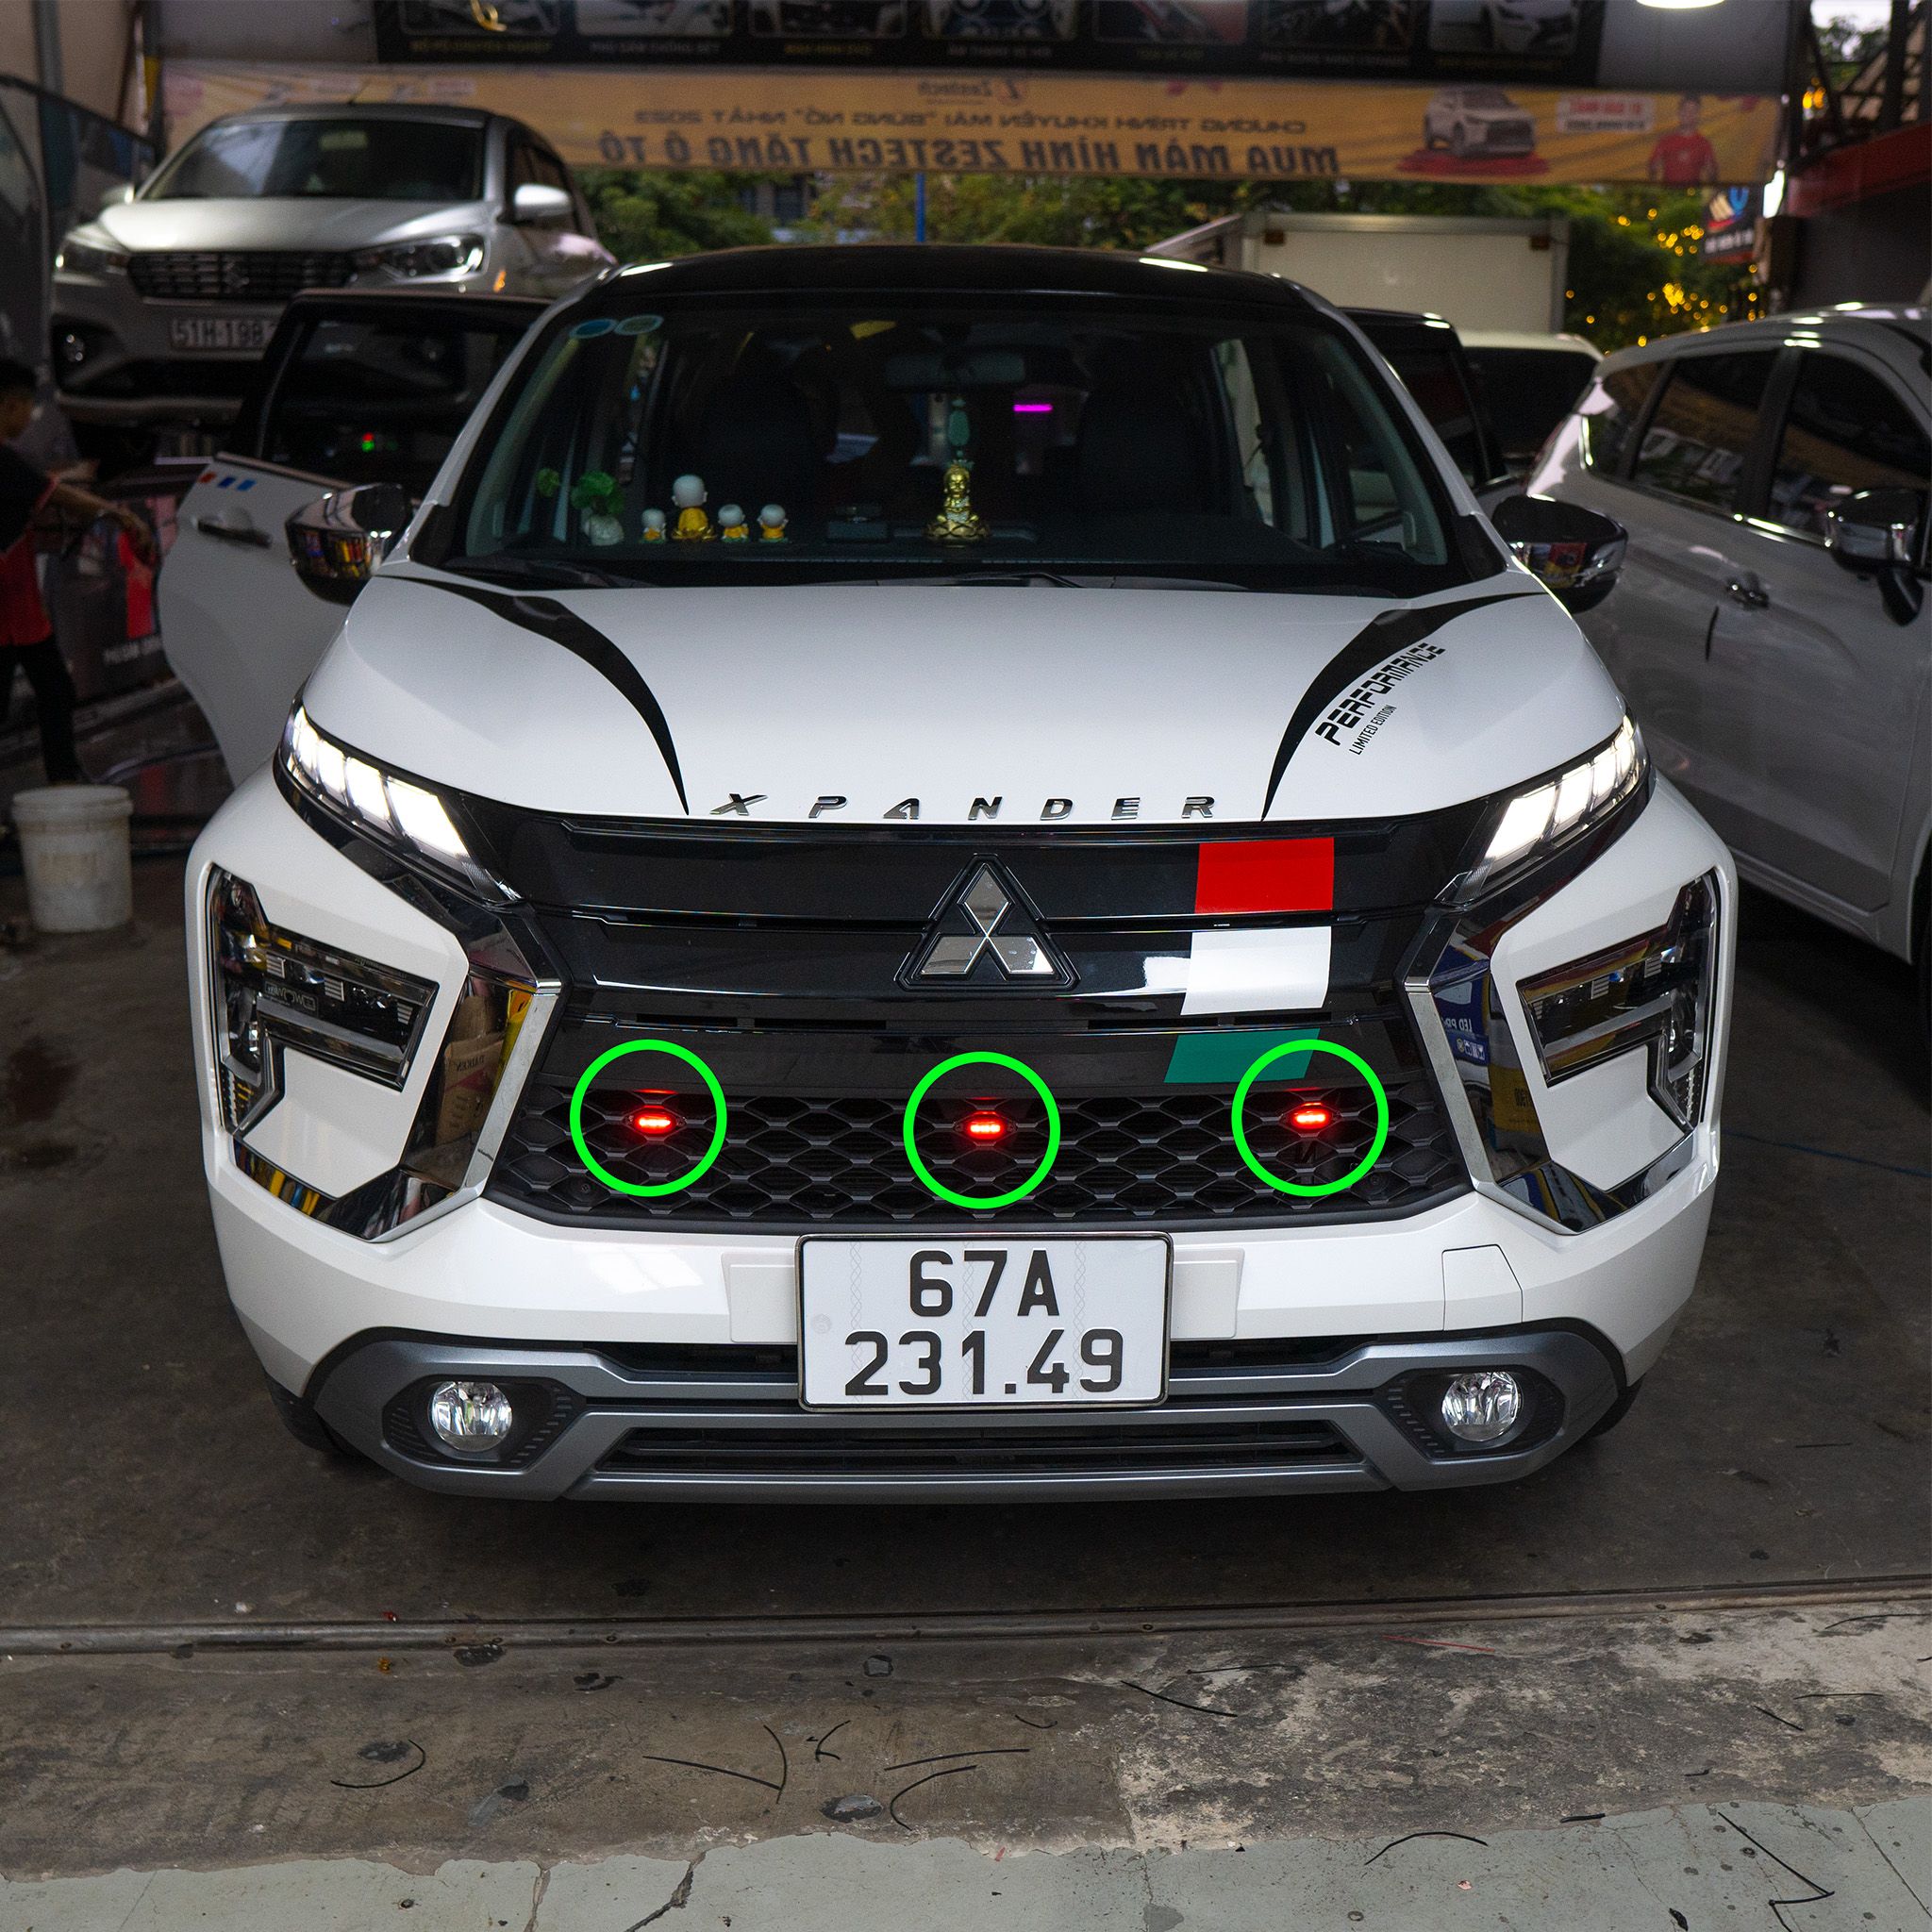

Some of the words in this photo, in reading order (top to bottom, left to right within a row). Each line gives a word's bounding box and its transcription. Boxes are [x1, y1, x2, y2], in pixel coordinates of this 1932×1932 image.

[1315, 642, 1446, 746] PERFORMANCE
[1349, 724, 1378, 756] LIMITED
[1371, 705, 1397, 725] EDITION
[709, 793, 1216, 821] XPANDER
[909, 1249, 1060, 1318] 67A
[845, 1328, 1124, 1396] 231.49
